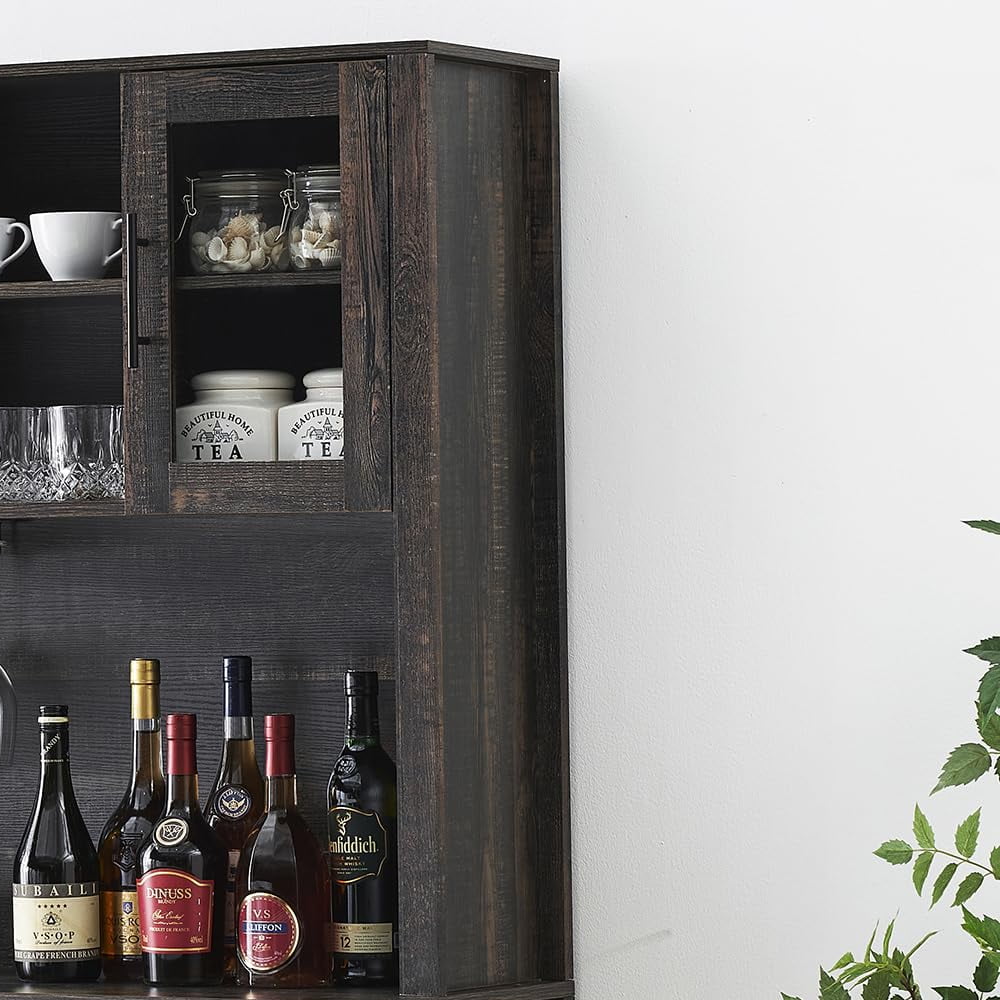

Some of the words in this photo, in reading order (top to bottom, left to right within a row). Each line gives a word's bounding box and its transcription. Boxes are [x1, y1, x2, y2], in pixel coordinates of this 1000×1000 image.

[180, 410, 227, 438] BEAUTIFUL
[228, 415, 254, 437] HOME
[290, 407, 337, 435] BEAUTIFUL
[191, 444, 243, 460] TEA
[146, 887, 192, 900] DINUSS
[247, 923, 283, 932] LIFFON
[340, 936, 351, 948] 12
[46, 951, 77, 960] FRENCH
